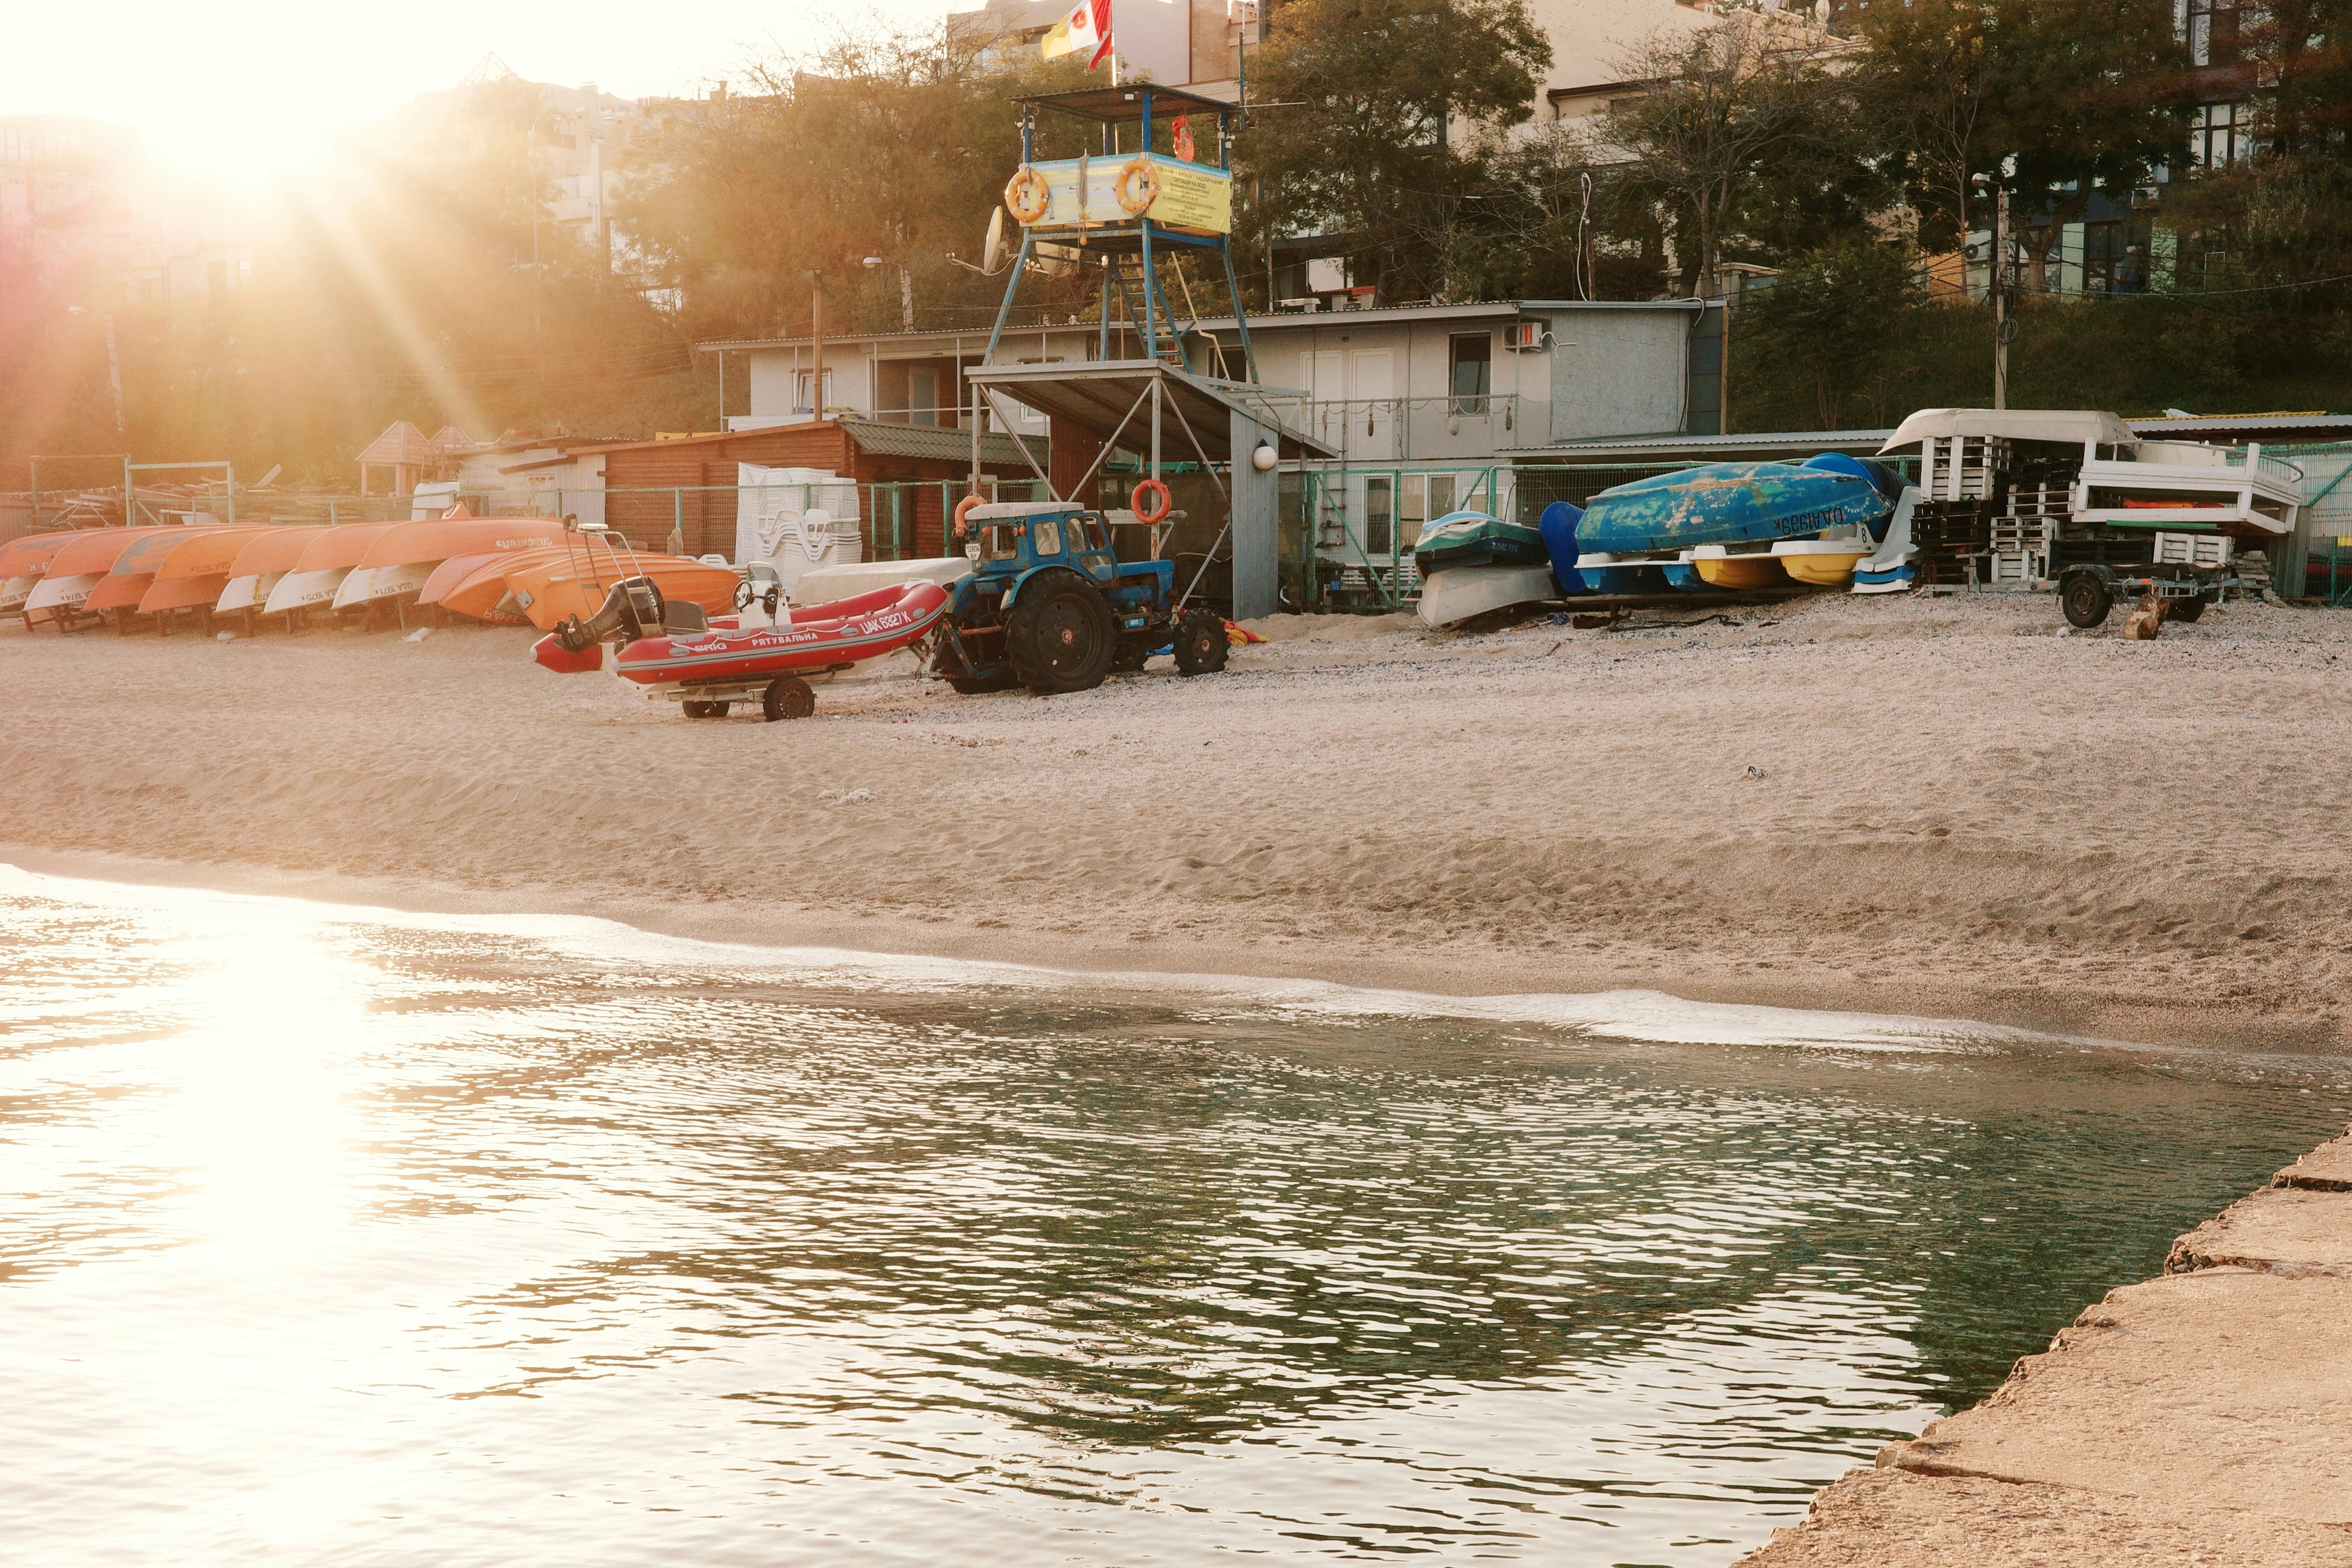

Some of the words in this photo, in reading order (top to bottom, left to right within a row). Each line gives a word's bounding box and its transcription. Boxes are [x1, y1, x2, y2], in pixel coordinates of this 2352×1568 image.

[1178, 171, 1195, 179] ВИПАДКУ
[1861, 528, 1867, 544] 8
[380, 586, 395, 595] 1971
[397, 582, 413, 591] ОДА
[19, 591, 31, 599] ДА
[66, 593, 82, 601] 1974
[306, 592, 323, 601] 1975
[859, 619, 883, 634] UAK
[879, 612, 902, 629] 6327
[752, 632, 818, 646] РЯТУВАЛЬНА
[694, 643, 727, 652] BRIG
